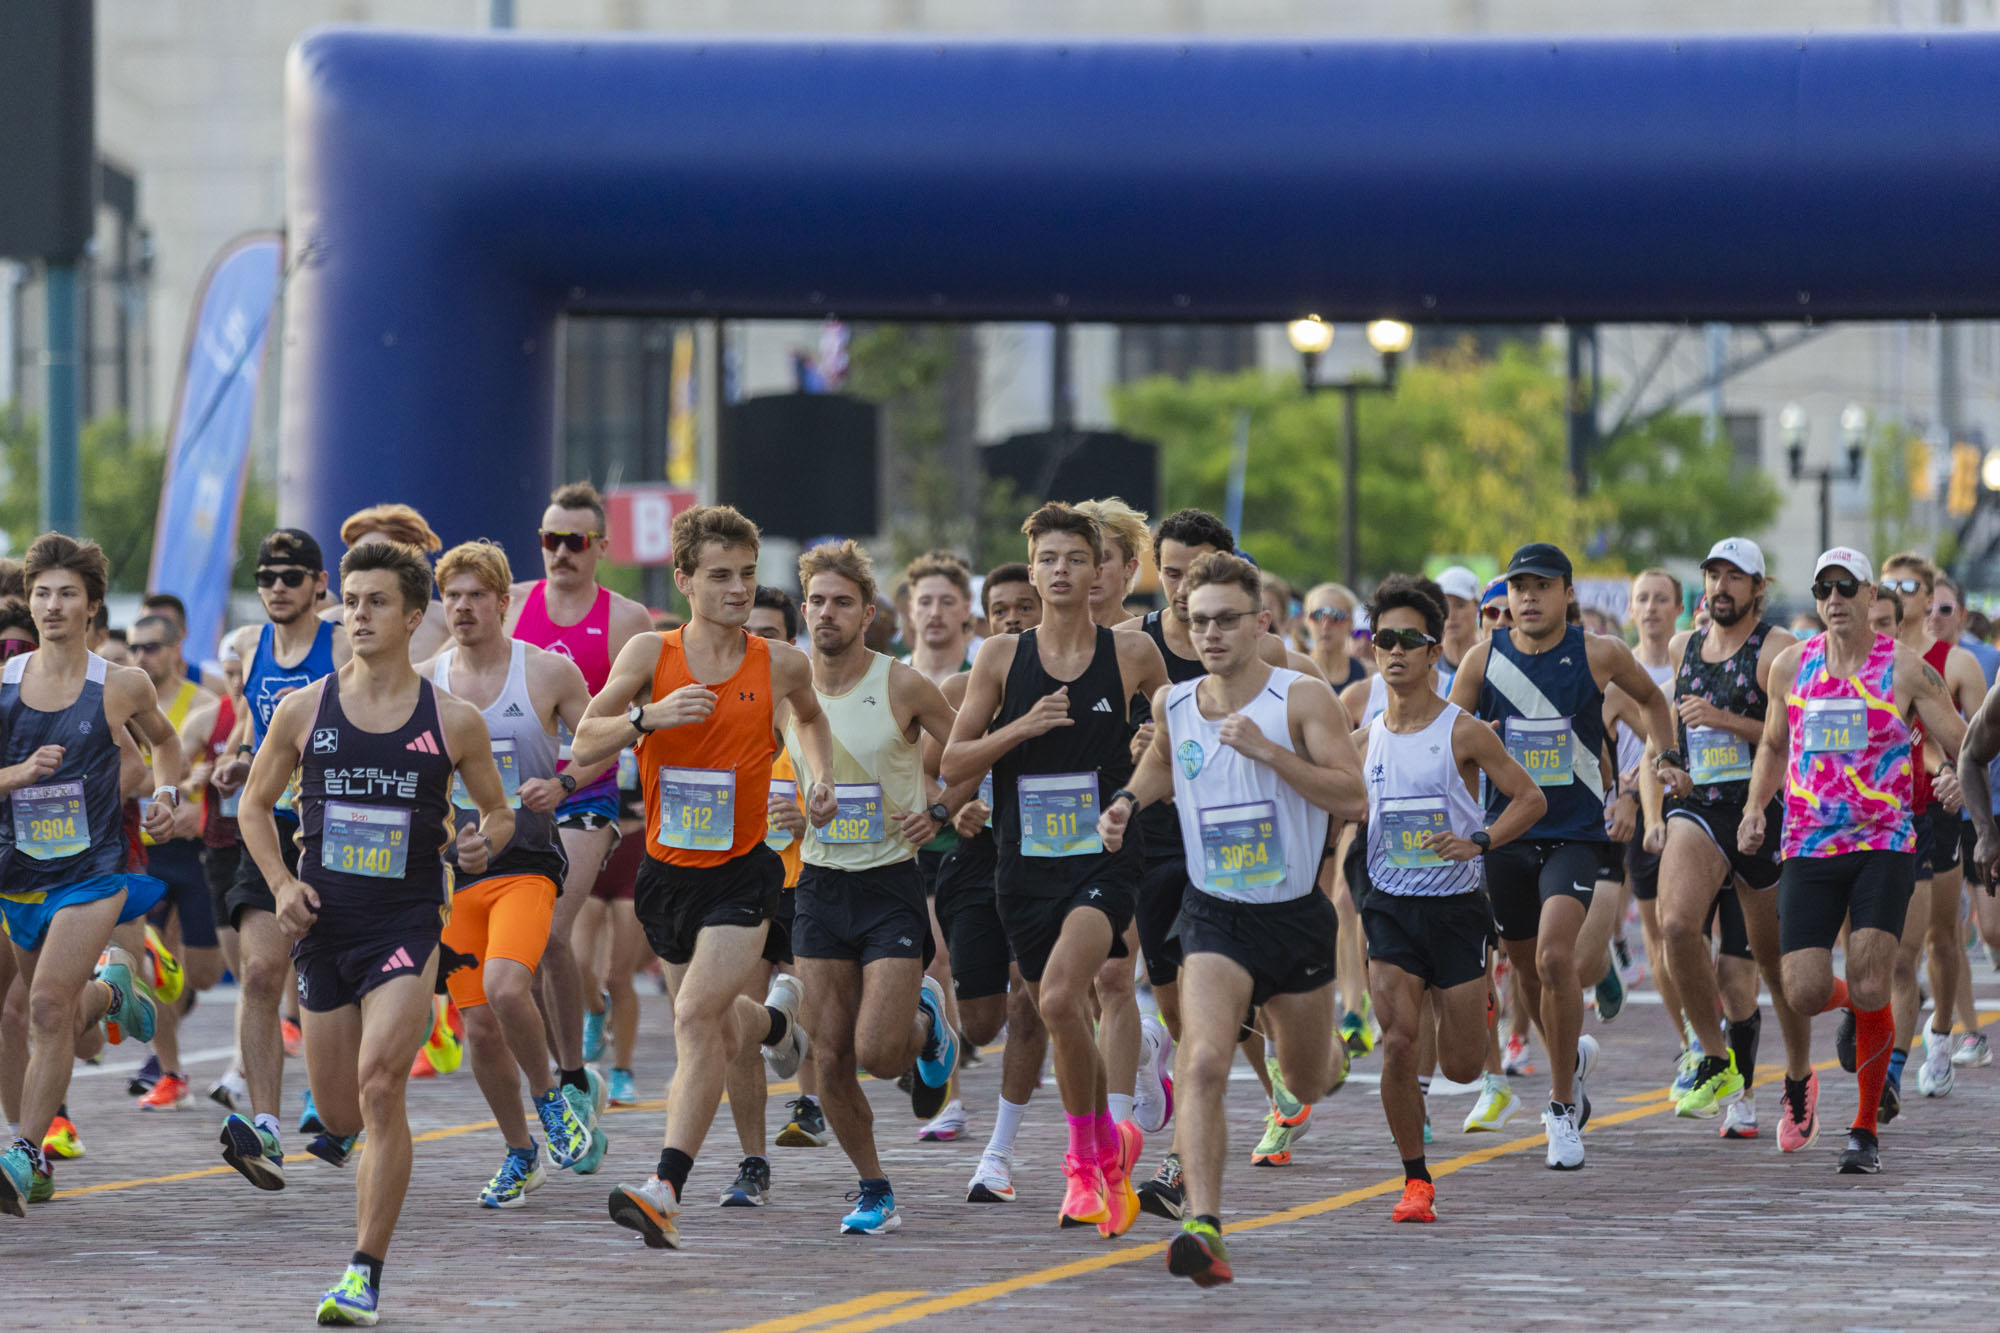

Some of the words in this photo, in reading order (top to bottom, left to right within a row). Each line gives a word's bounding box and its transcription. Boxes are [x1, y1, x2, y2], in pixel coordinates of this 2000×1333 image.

[631, 492, 672, 561] B
[1821, 728, 1850, 748] 714
[502, 755, 513, 764] 10
[1523, 749, 1560, 769] 1675
[1701, 745, 1739, 767] 3056
[324, 768, 419, 783] GAZELLE
[325, 779, 418, 799] ELITE
[717, 790, 728, 799] 10
[1080, 792, 1093, 803] 10
[67, 800, 80, 809] 10
[864, 801, 876, 810] 10
[681, 805, 713, 830] 512
[1046, 812, 1078, 836] 511
[31, 817, 76, 841] 2904
[390, 830, 403, 841] 10
[828, 818, 870, 840] 4392
[1259, 823, 1273, 833] 10
[342, 845, 391, 873] 3140
[1220, 841, 1269, 870] 3054
